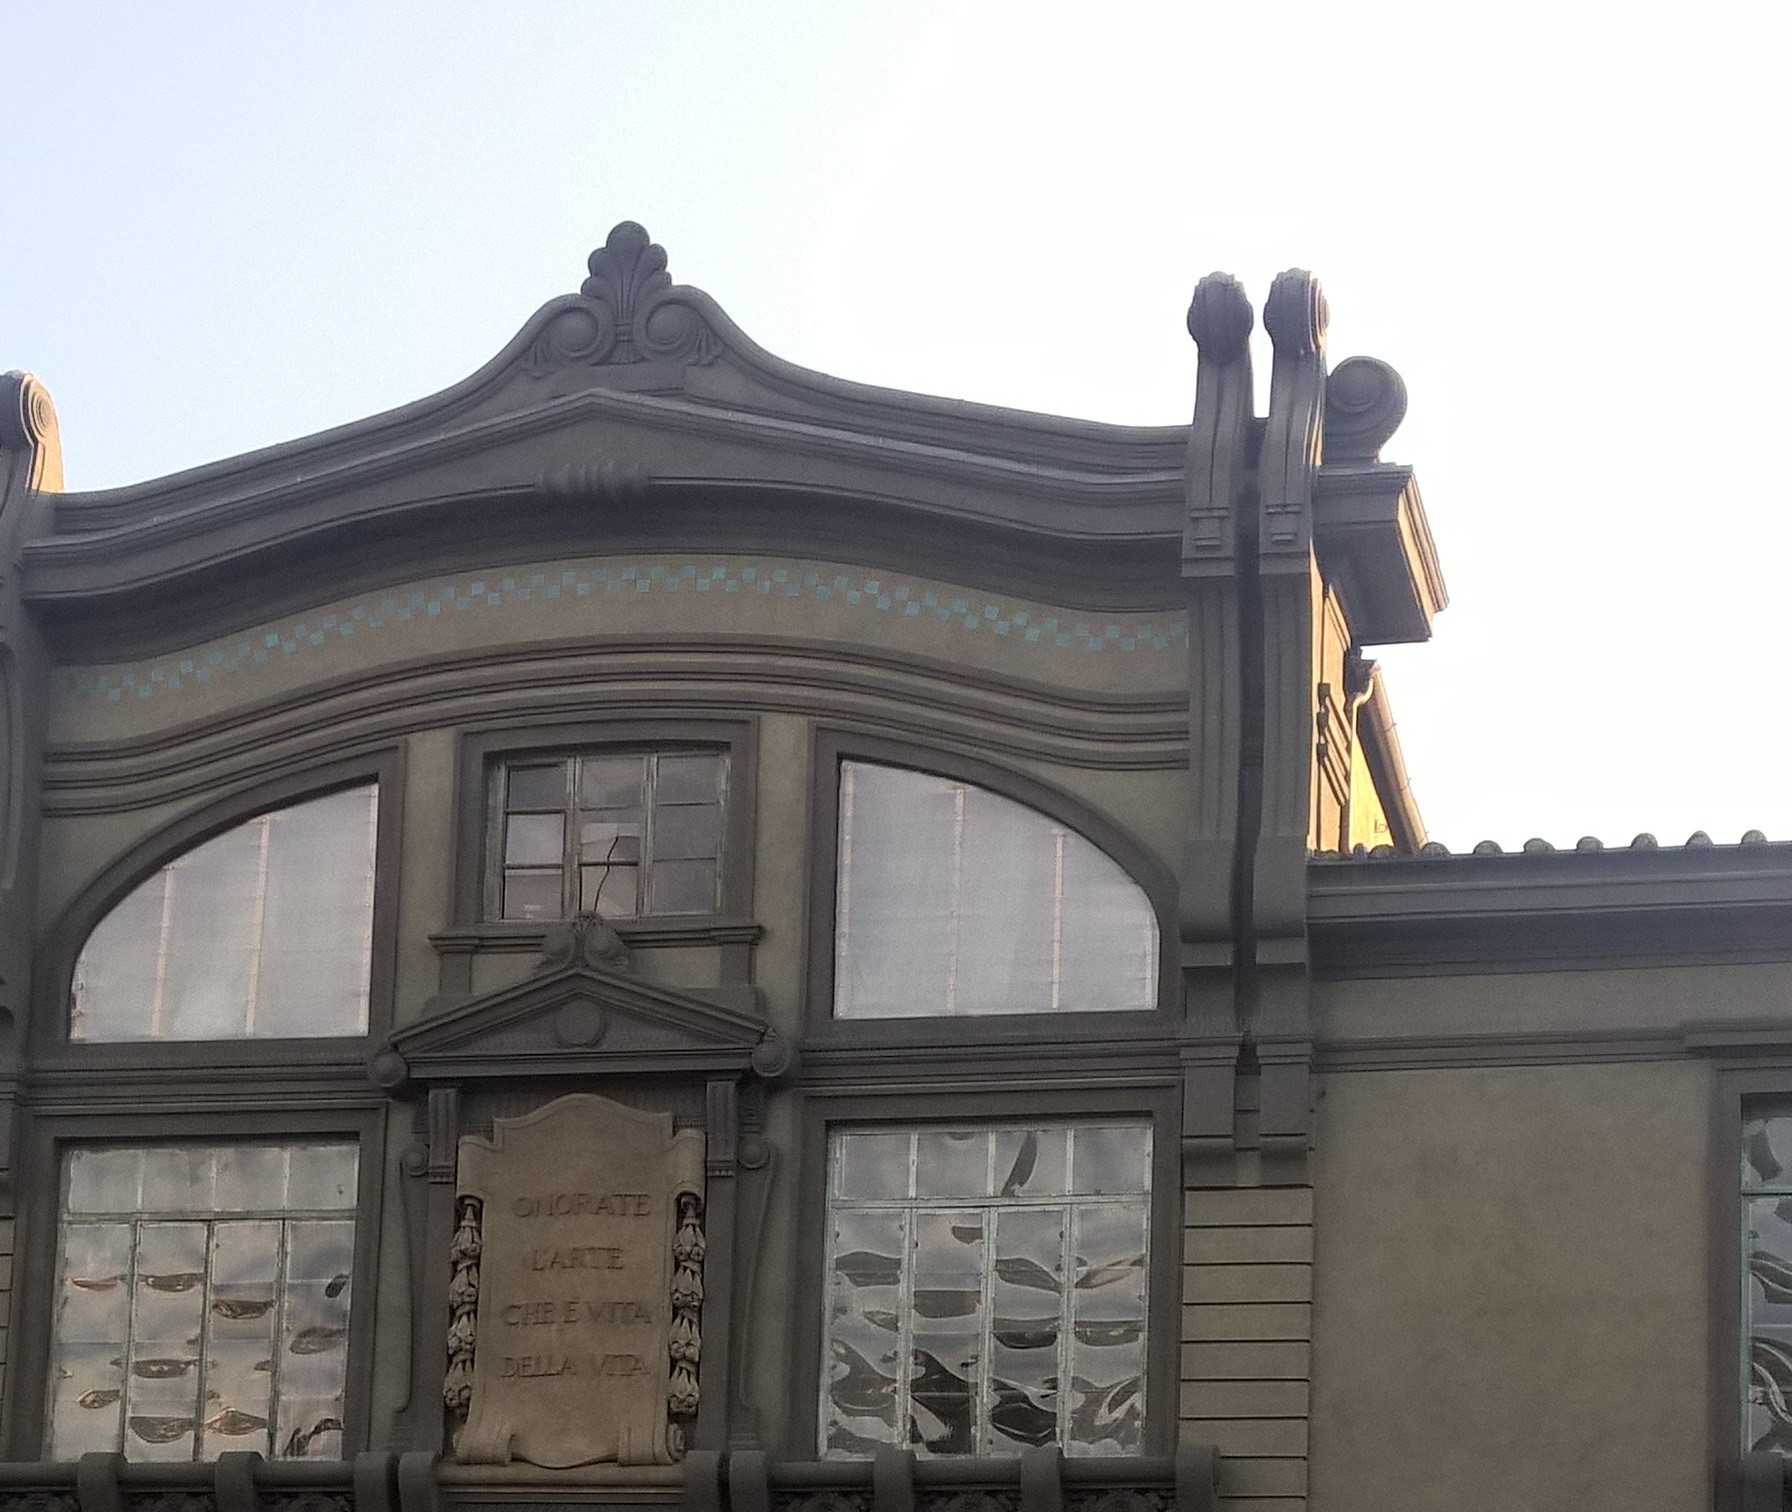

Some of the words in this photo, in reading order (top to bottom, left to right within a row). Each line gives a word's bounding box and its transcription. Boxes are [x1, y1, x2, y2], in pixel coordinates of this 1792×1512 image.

[513, 1193, 652, 1218] ONORATE
[500, 1301, 555, 1326] CHE
[586, 1301, 652, 1325] VITA
[500, 1353, 578, 1378] DELLA
[592, 1353, 651, 1377] VITA
